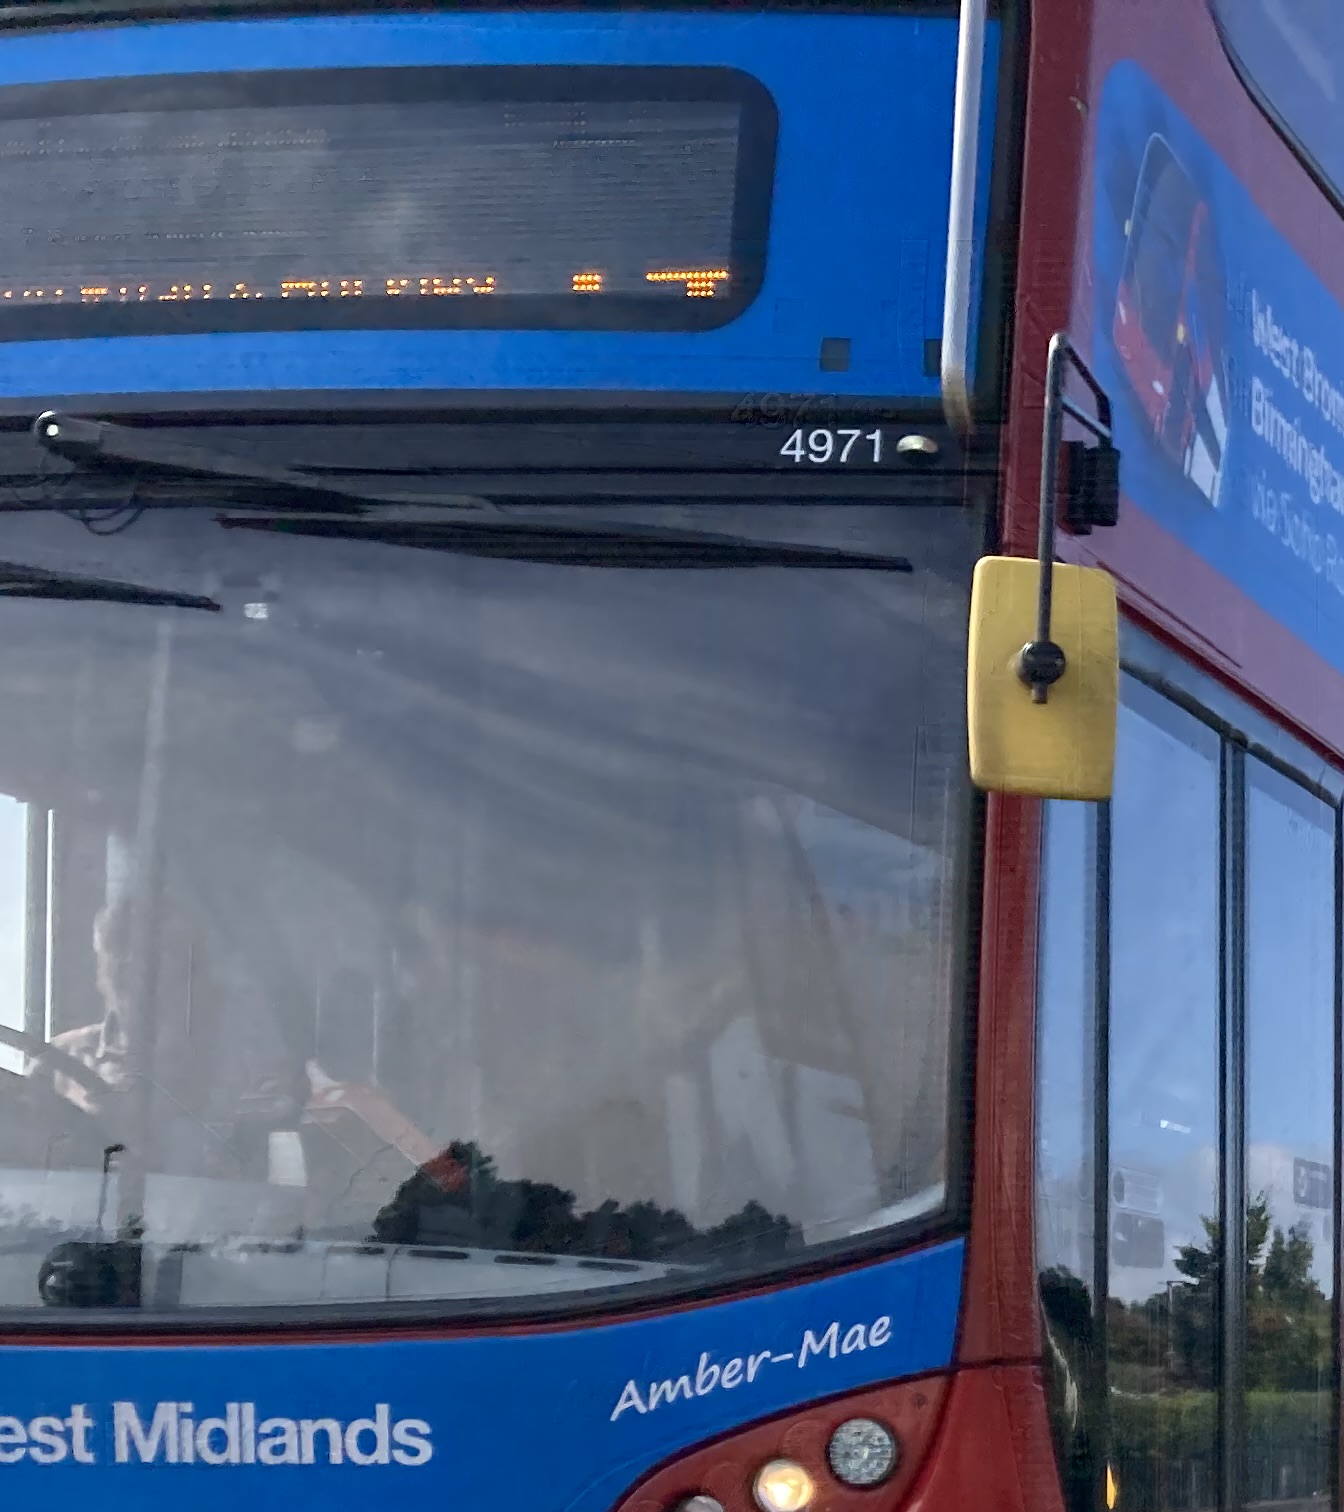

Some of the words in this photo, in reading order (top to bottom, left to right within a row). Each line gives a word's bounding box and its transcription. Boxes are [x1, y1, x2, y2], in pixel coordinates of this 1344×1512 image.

[1252, 287, 1299, 388] West
[780, 428, 882, 464] 4971
[609, 1313, 893, 1422] Amber-Mae
[0, 1403, 95, 1464] est
[115, 1402, 433, 1466] Midlands
